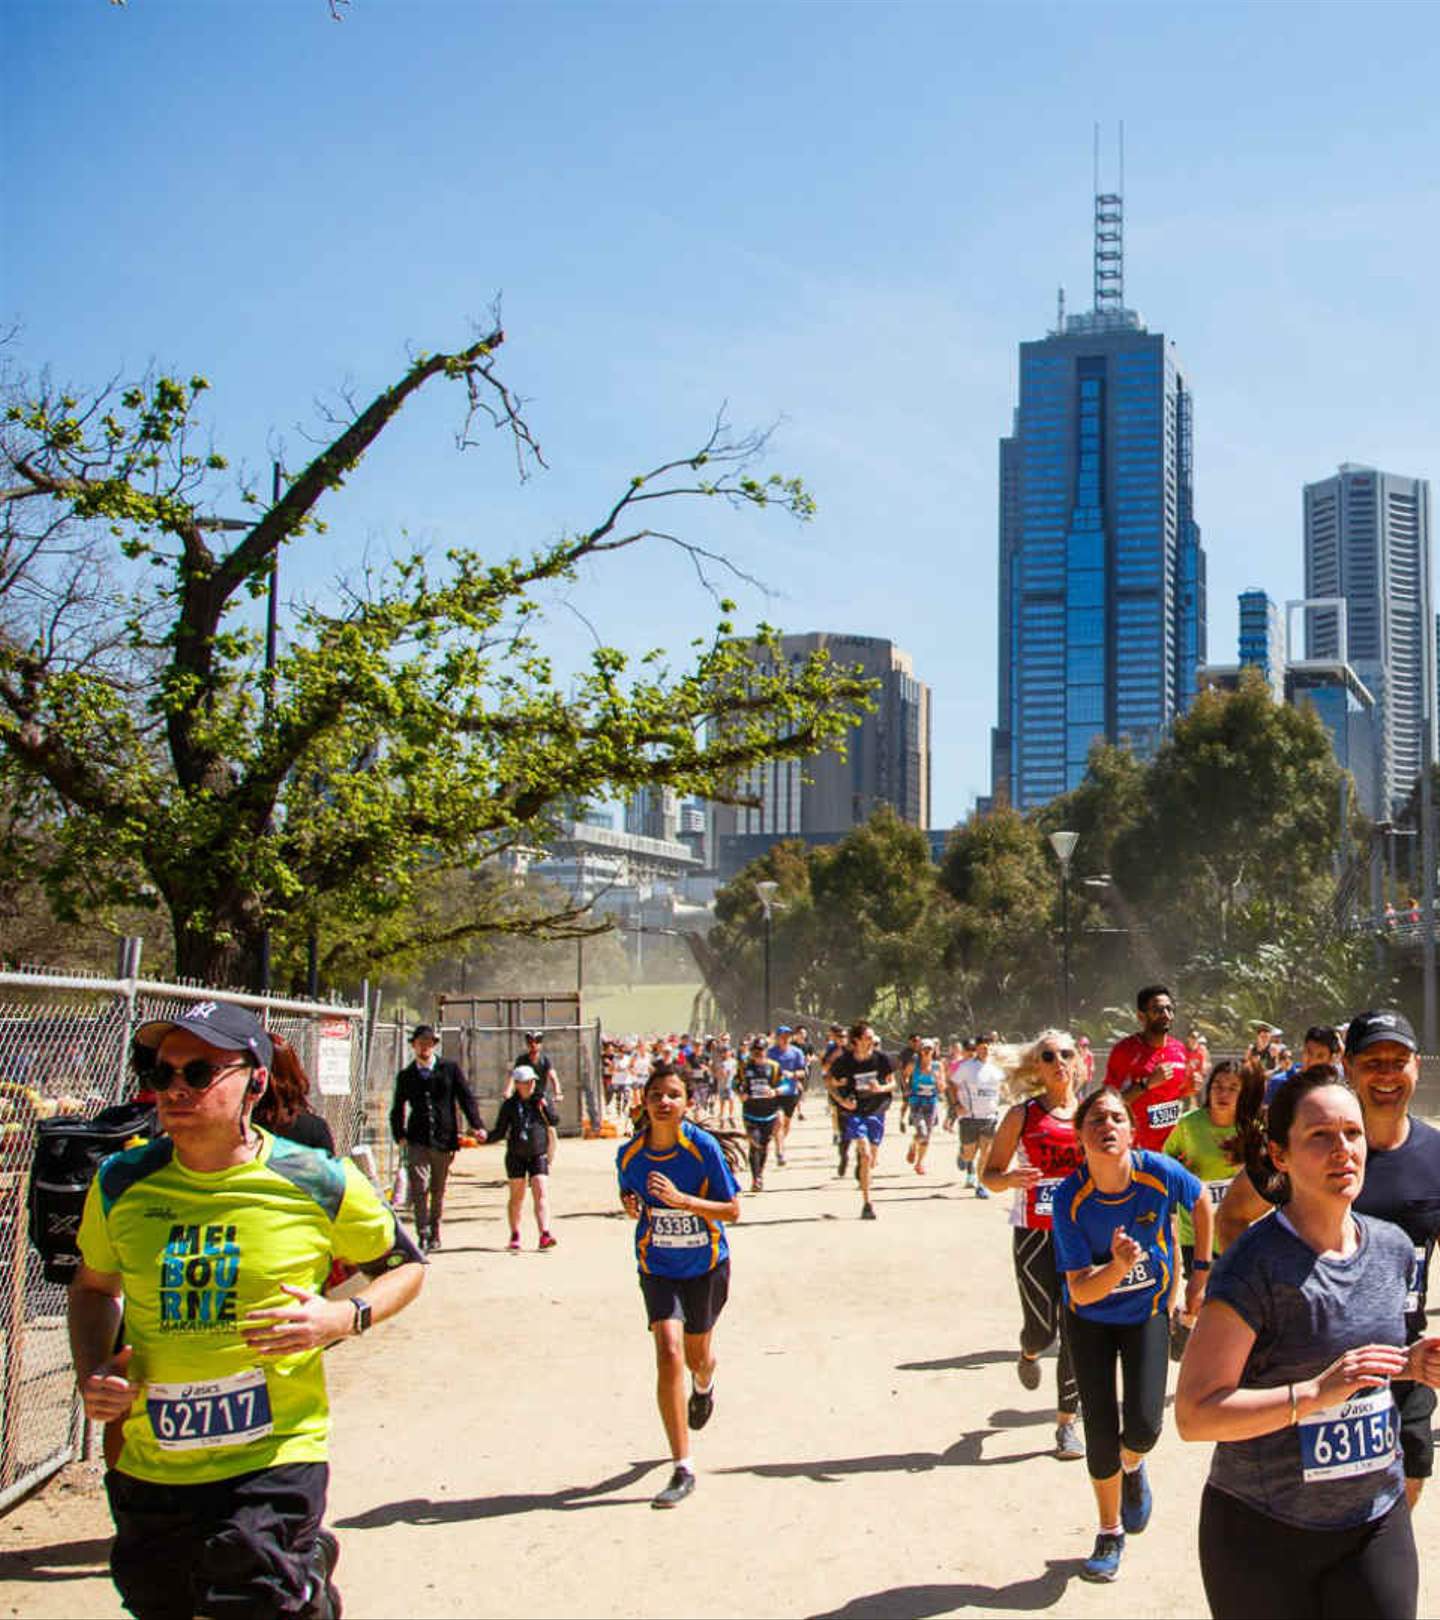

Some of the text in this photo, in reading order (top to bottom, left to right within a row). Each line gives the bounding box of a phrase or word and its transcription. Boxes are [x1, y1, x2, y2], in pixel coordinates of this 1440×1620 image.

[164, 1225, 240, 1256] MEL
[655, 1216, 699, 1234] 63381
[160, 1257, 240, 1288] BOU
[159, 1290, 237, 1321] RNE
[160, 1391, 256, 1438] 62717
[1314, 1411, 1395, 1465] 63156
